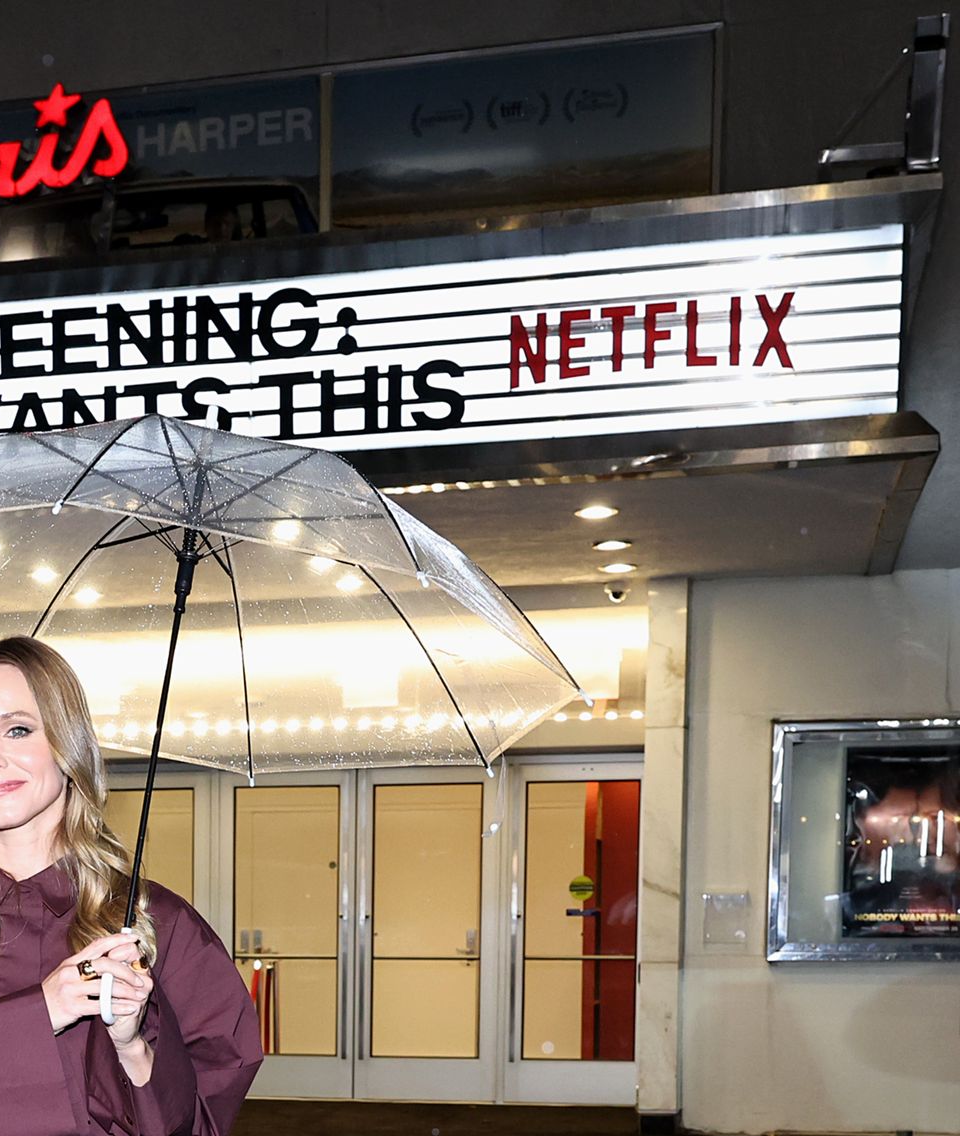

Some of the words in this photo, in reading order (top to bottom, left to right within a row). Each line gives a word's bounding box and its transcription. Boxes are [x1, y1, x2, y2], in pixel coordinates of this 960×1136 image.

[136, 107, 313, 159] HARPER
[508, 291, 796, 389] NETFLIX
[258, 359, 466, 441] THIS
